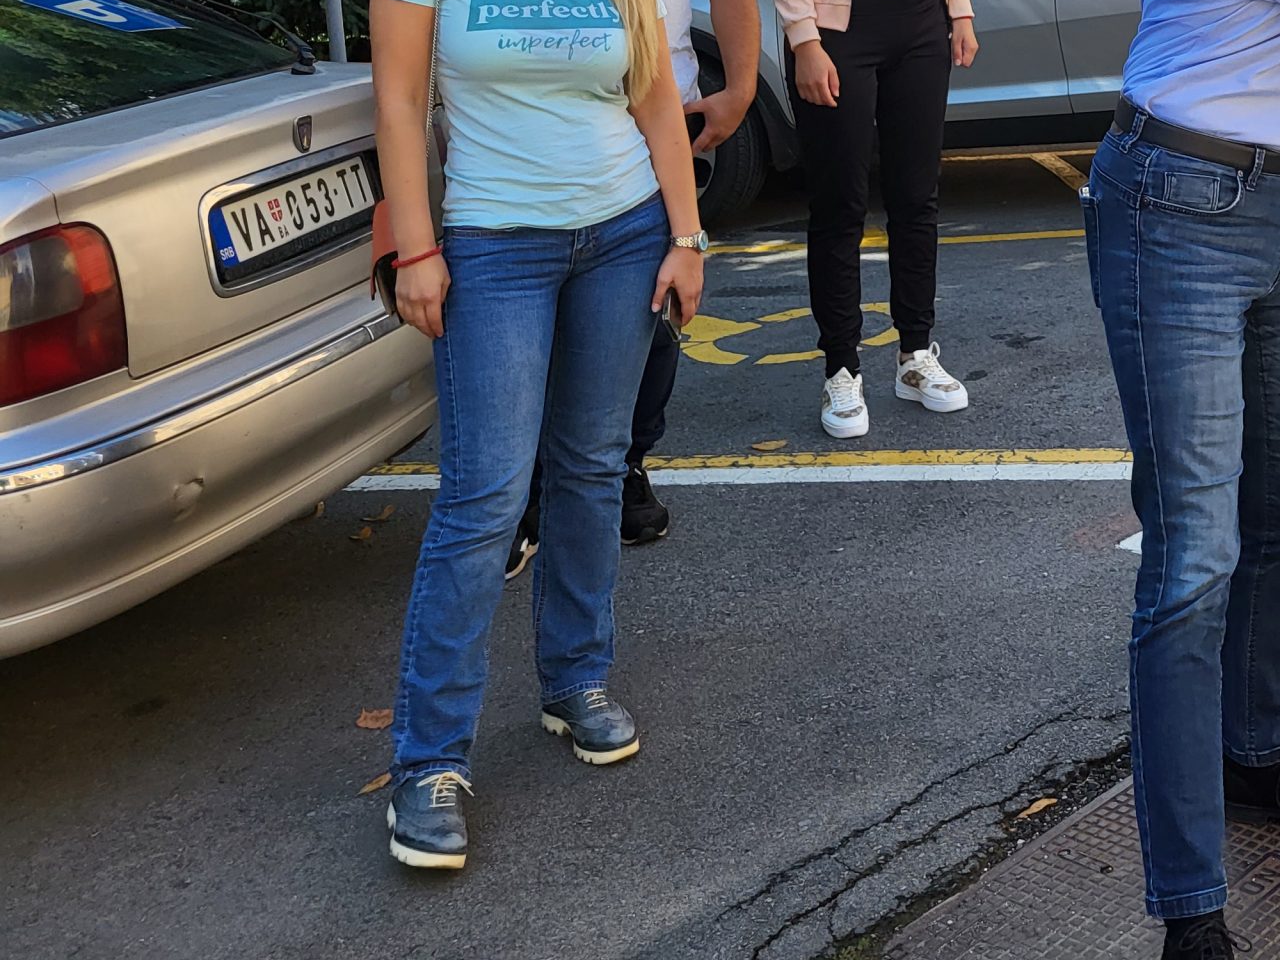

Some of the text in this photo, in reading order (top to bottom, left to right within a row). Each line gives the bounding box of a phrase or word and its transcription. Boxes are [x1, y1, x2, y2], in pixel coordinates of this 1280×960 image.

[475, 0, 620, 25] perfectly
[498, 29, 612, 60] imperfect
[230, 203, 275, 252] VA
[219, 246, 235, 260] SRB
